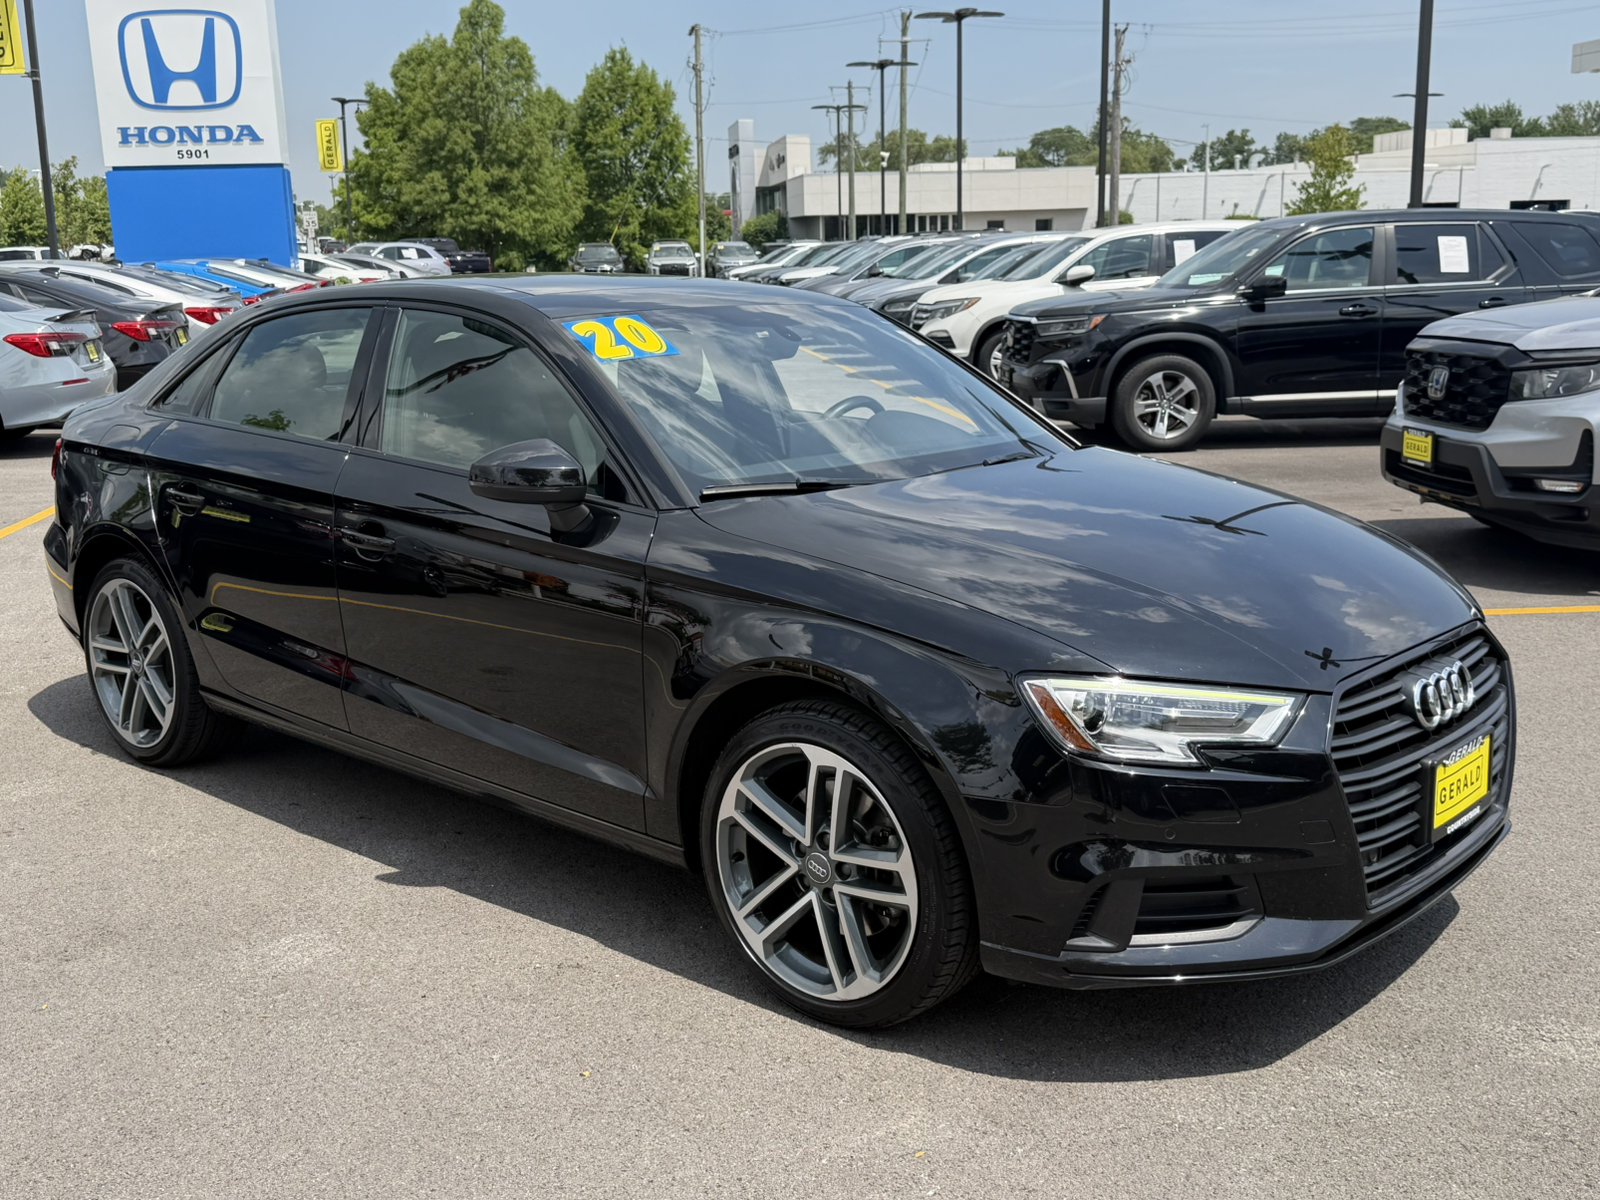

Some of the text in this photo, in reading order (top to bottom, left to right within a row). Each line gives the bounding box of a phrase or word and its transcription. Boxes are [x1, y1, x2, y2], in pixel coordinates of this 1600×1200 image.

[117, 124, 264, 145] HONDA
[324, 126, 335, 165] GERALD
[177, 149, 209, 159] 5901
[305, 220, 317, 228] 35
[571, 317, 668, 360] 20
[1406, 441, 1428, 454] GERALD
[778, 722, 885, 774] GOODYEAR
[1448, 735, 1483, 765] GERALD
[1439, 765, 1481, 805] GERALD
